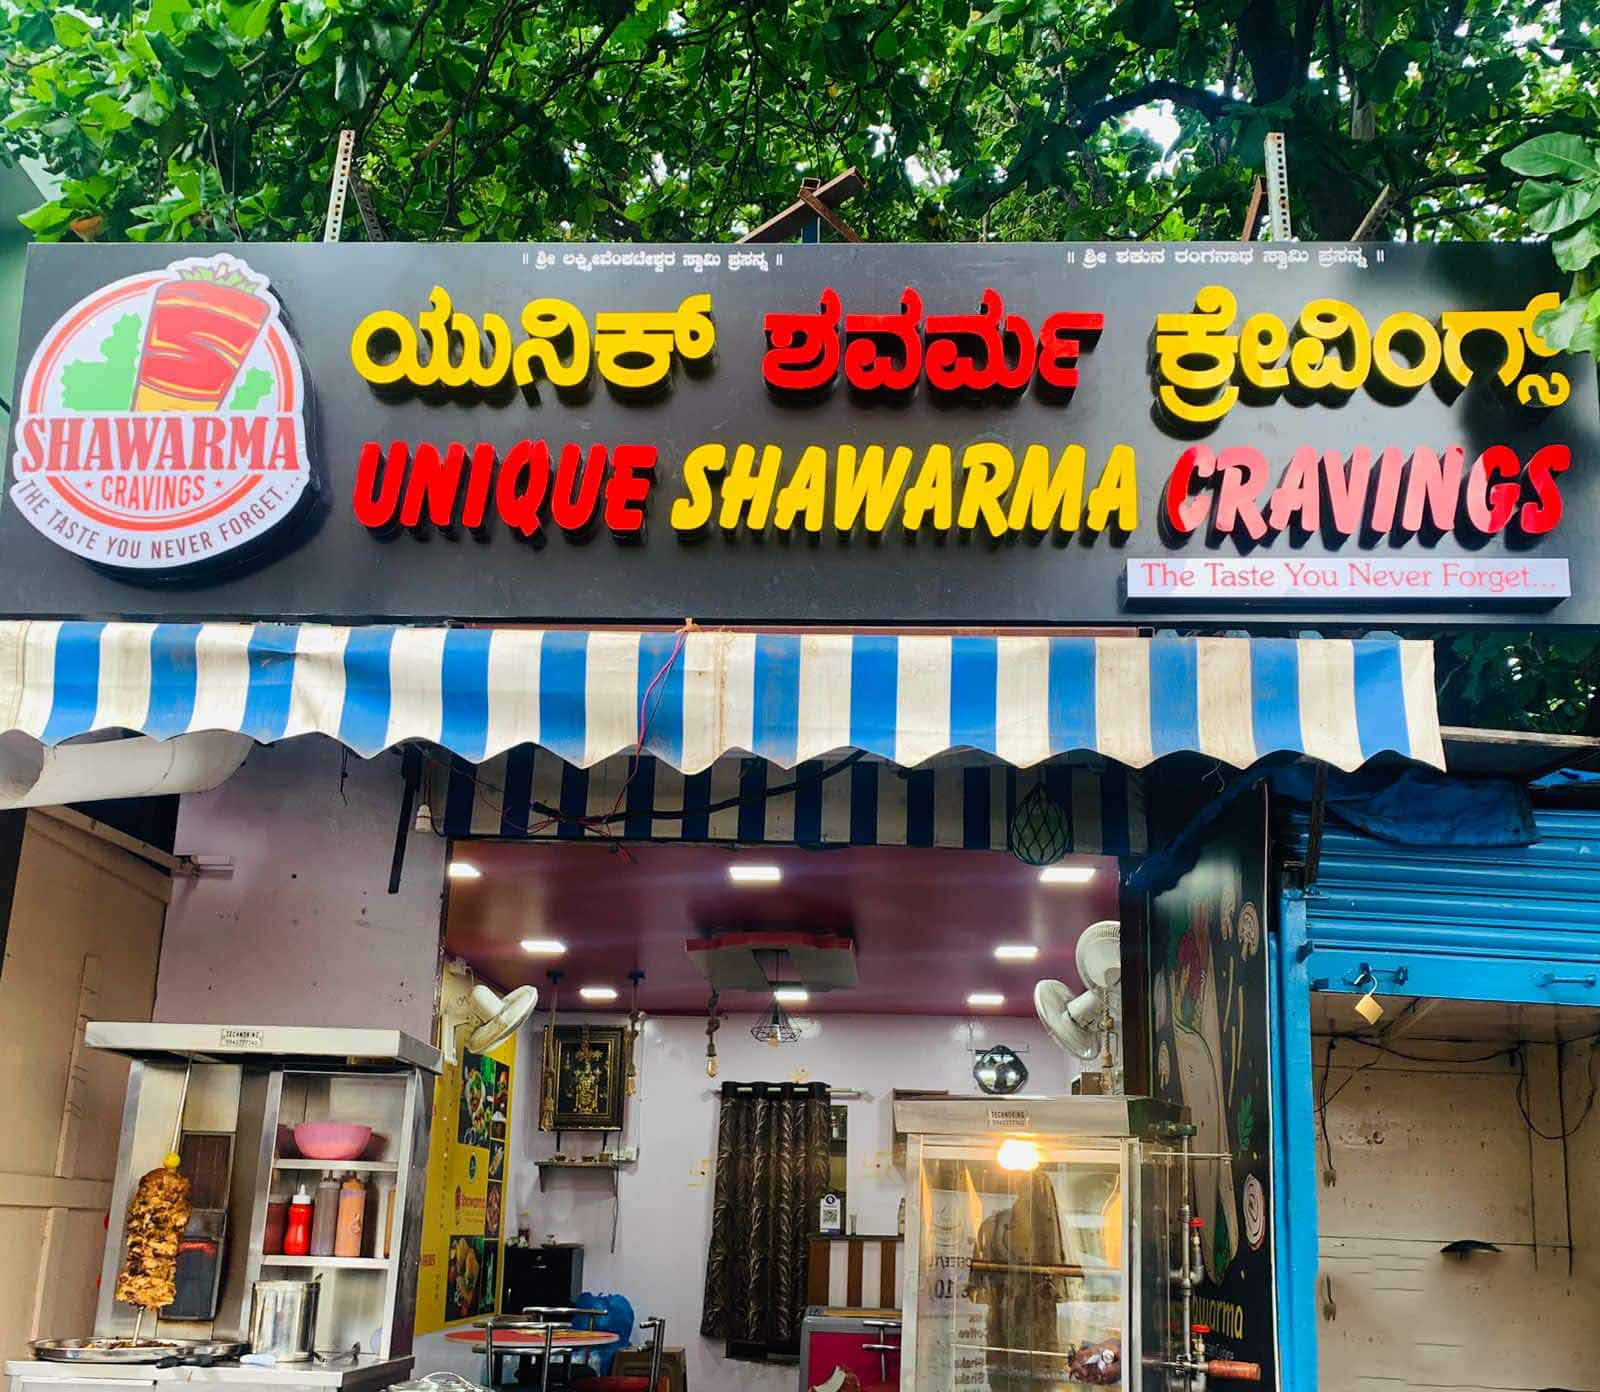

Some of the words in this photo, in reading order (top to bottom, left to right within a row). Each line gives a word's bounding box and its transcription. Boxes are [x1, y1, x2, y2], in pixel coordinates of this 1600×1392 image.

[535, 250, 556, 270] ಶ್ರೀ
[682, 252, 721, 272] ಸ್ವಾಮಿ
[1082, 248, 1107, 269] ಶ್ರೀ
[1263, 249, 1309, 270] ಸ್ವಾಮಿ
[351, 285, 716, 389] ಯುನಿಕ್
[761, 287, 1105, 391] ಶವರ್ಮ
[1155, 285, 1571, 422] ಕ್ರೇವಿಂಗ್ಸ್
[21, 415, 300, 473] SHAWARMA
[100, 475, 206, 512] CRAVINGS
[352, 438, 658, 537] UNIQUE
[670, 441, 1139, 538] SHAWARMA
[1166, 443, 1572, 541] CRAVINGS
[18, 480, 49, 508] THE
[48, 509, 101, 551] TASTE
[106, 536, 142, 560] YOU
[151, 529, 214, 560] NEVER
[1140, 561, 1196, 588] The
[1203, 561, 1276, 588] Taste
[1284, 561, 1340, 588] You
[1348, 561, 1433, 588] Never
